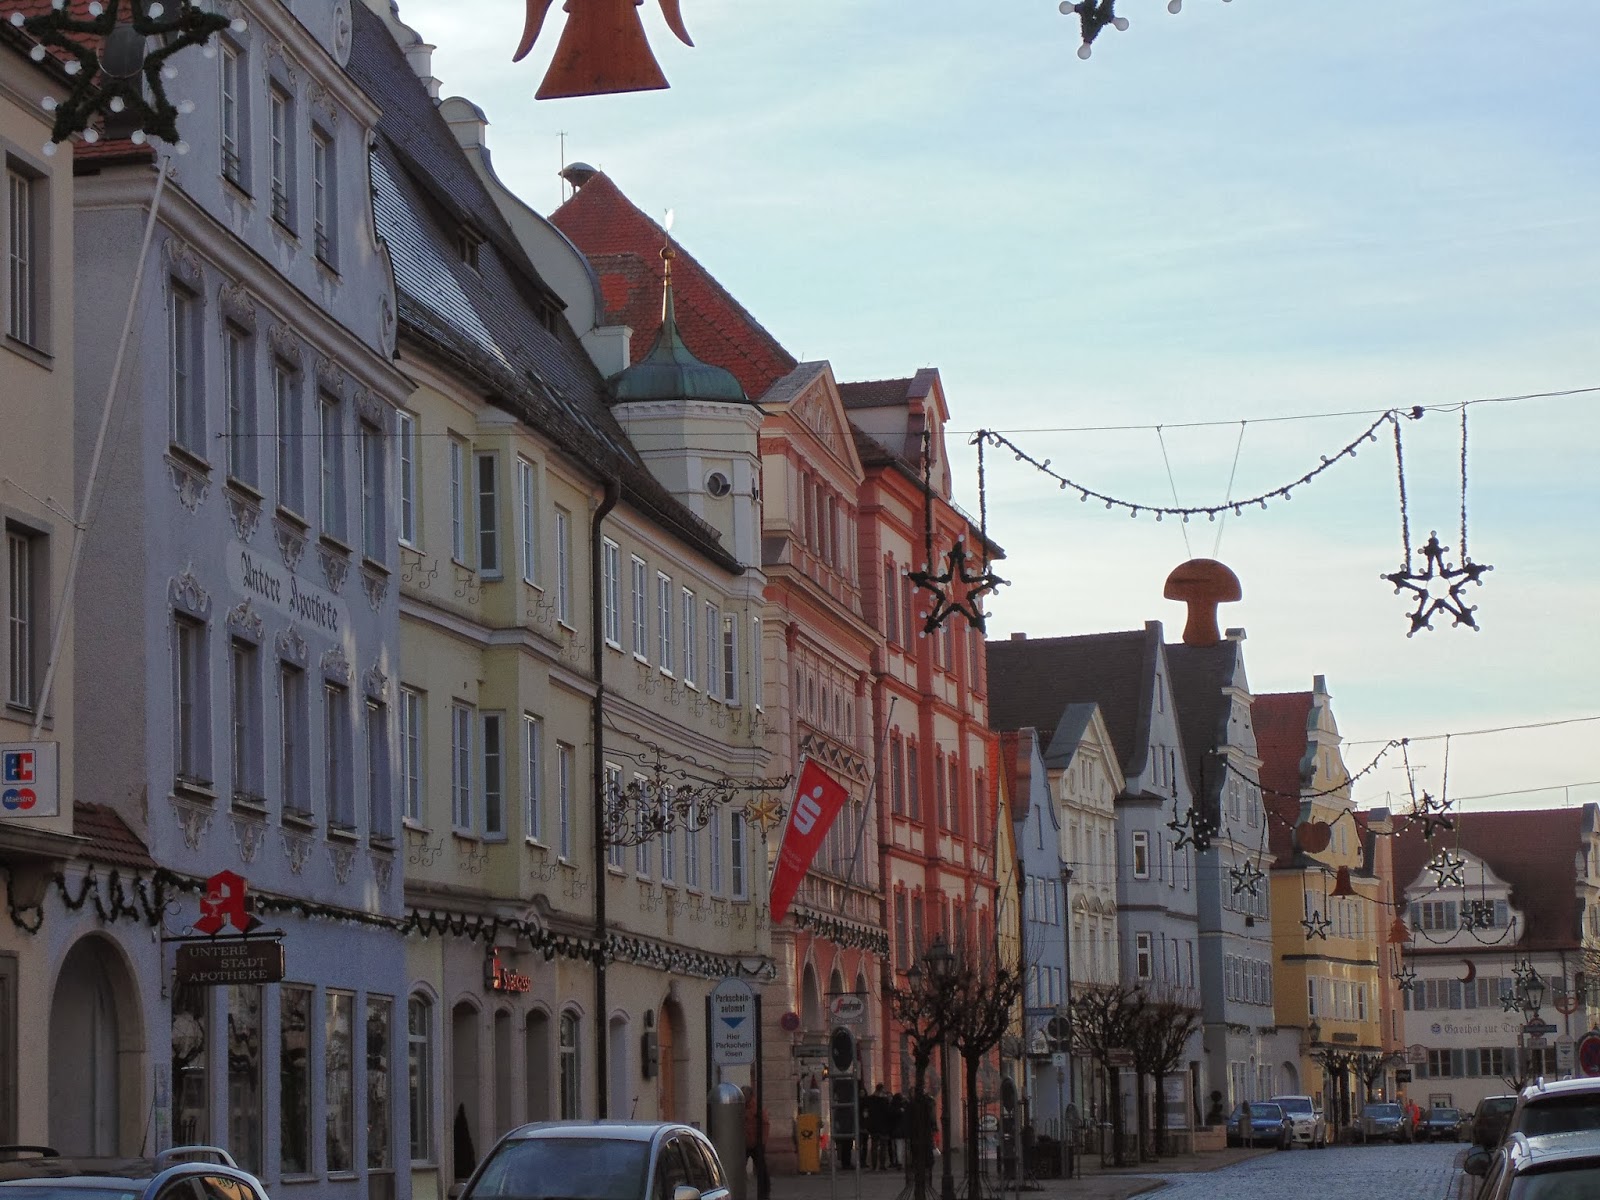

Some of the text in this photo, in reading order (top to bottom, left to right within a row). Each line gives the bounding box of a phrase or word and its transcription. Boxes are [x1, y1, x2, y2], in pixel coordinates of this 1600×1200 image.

[241, 551, 337, 632] Untere Apotheke
[5, 795, 33, 803] Maestro
[189, 945, 248, 956] UNTERE
[220, 957, 267, 968] STADT
[189, 969, 268, 982] APOTHEKE
[715, 993, 751, 1003] Parkschein-
[721, 1004, 745, 1013] automat
[1444, 1023, 1481, 1034] Gasthof
[1485, 1025, 1498, 1034] zur
[715, 1041, 752, 1049] Parkschein
